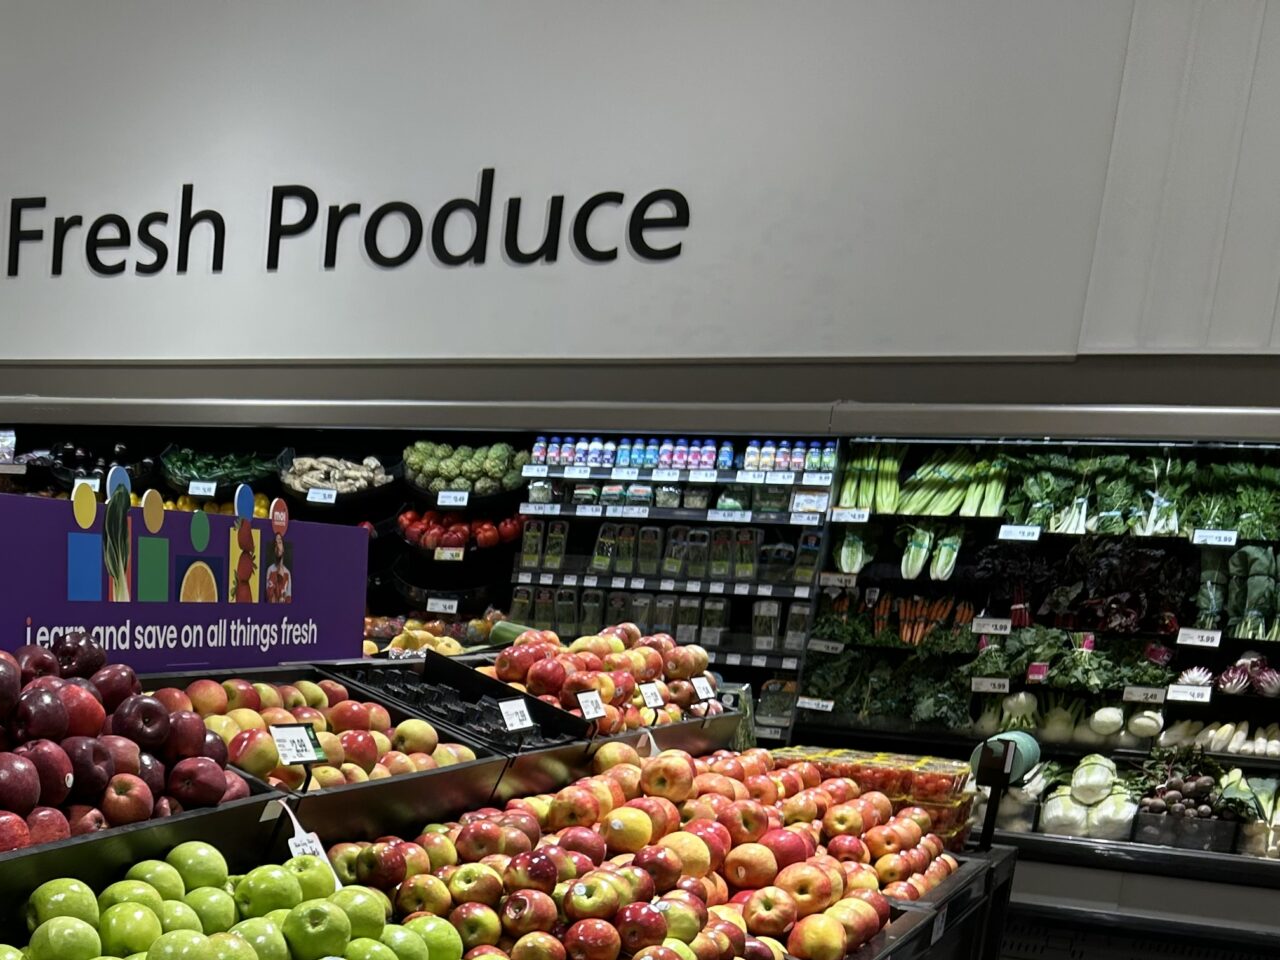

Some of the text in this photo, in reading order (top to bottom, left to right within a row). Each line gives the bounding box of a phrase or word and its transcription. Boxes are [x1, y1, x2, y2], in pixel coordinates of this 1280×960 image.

[7, 167, 691, 277] Fresh Produce
[91, 619, 131, 651] and
[134, 624, 178, 650] save
[181, 624, 204, 648] on
[207, 618, 227, 648] all
[230, 616, 278, 652] things
[281, 616, 318, 646] fresh
